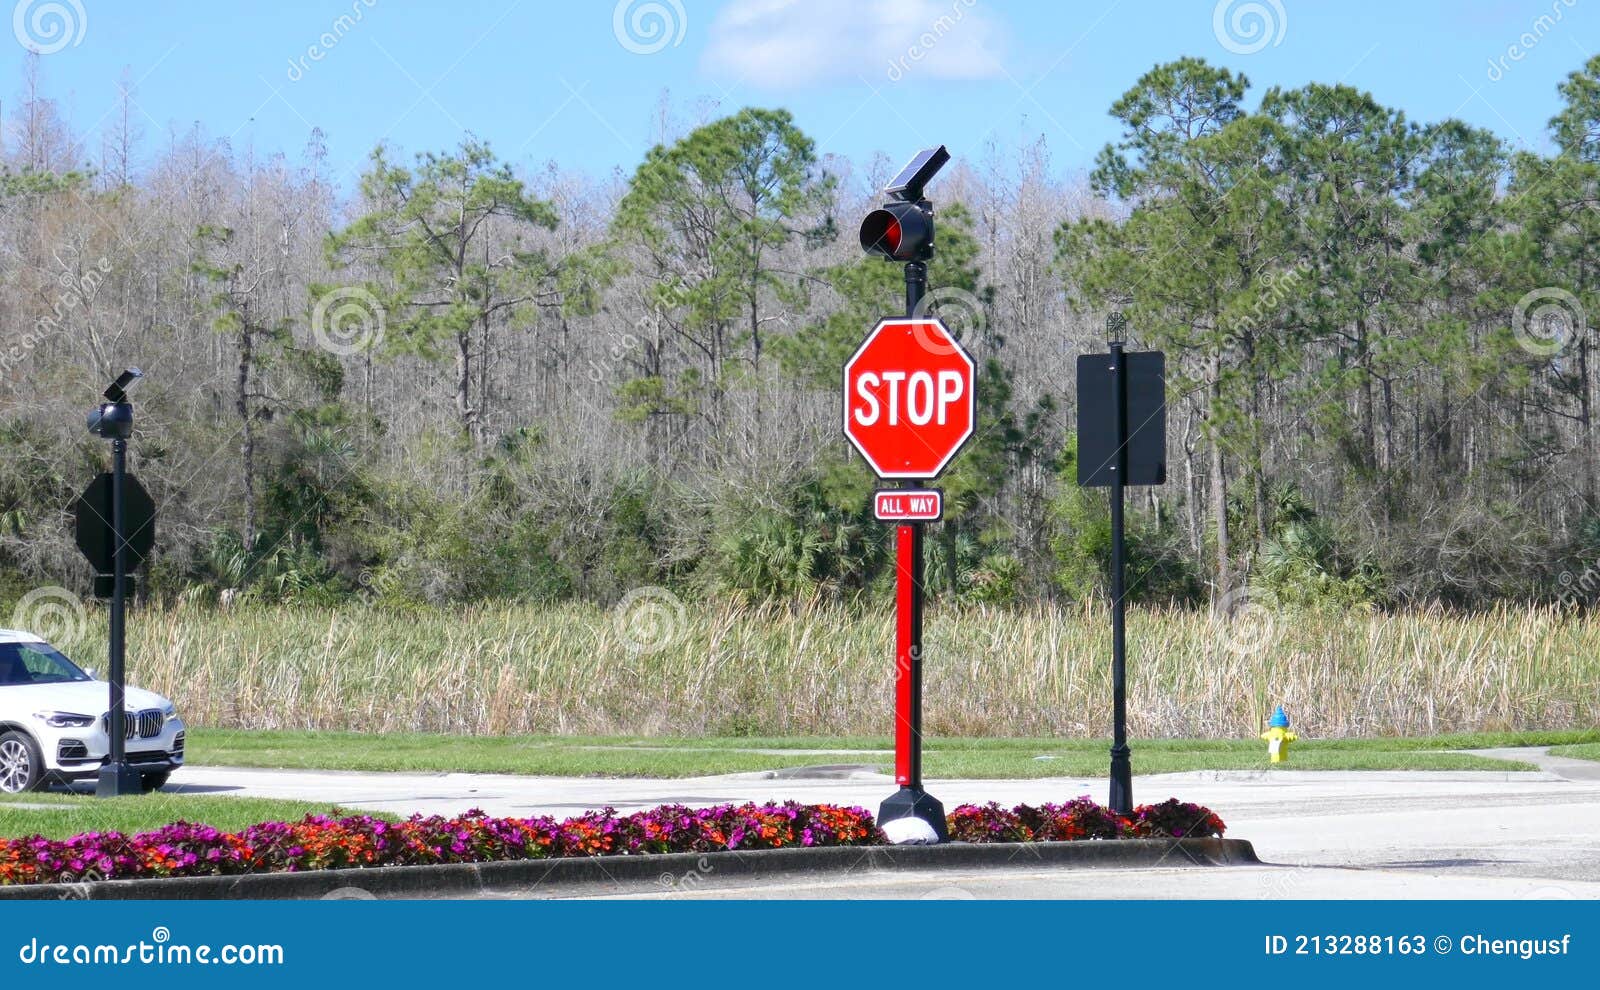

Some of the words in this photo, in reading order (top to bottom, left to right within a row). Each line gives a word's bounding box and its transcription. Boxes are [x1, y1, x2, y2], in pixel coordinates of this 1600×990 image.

[854, 370, 964, 426] STOP
[881, 498, 903, 514] ALL
[910, 498, 934, 513] WAY
